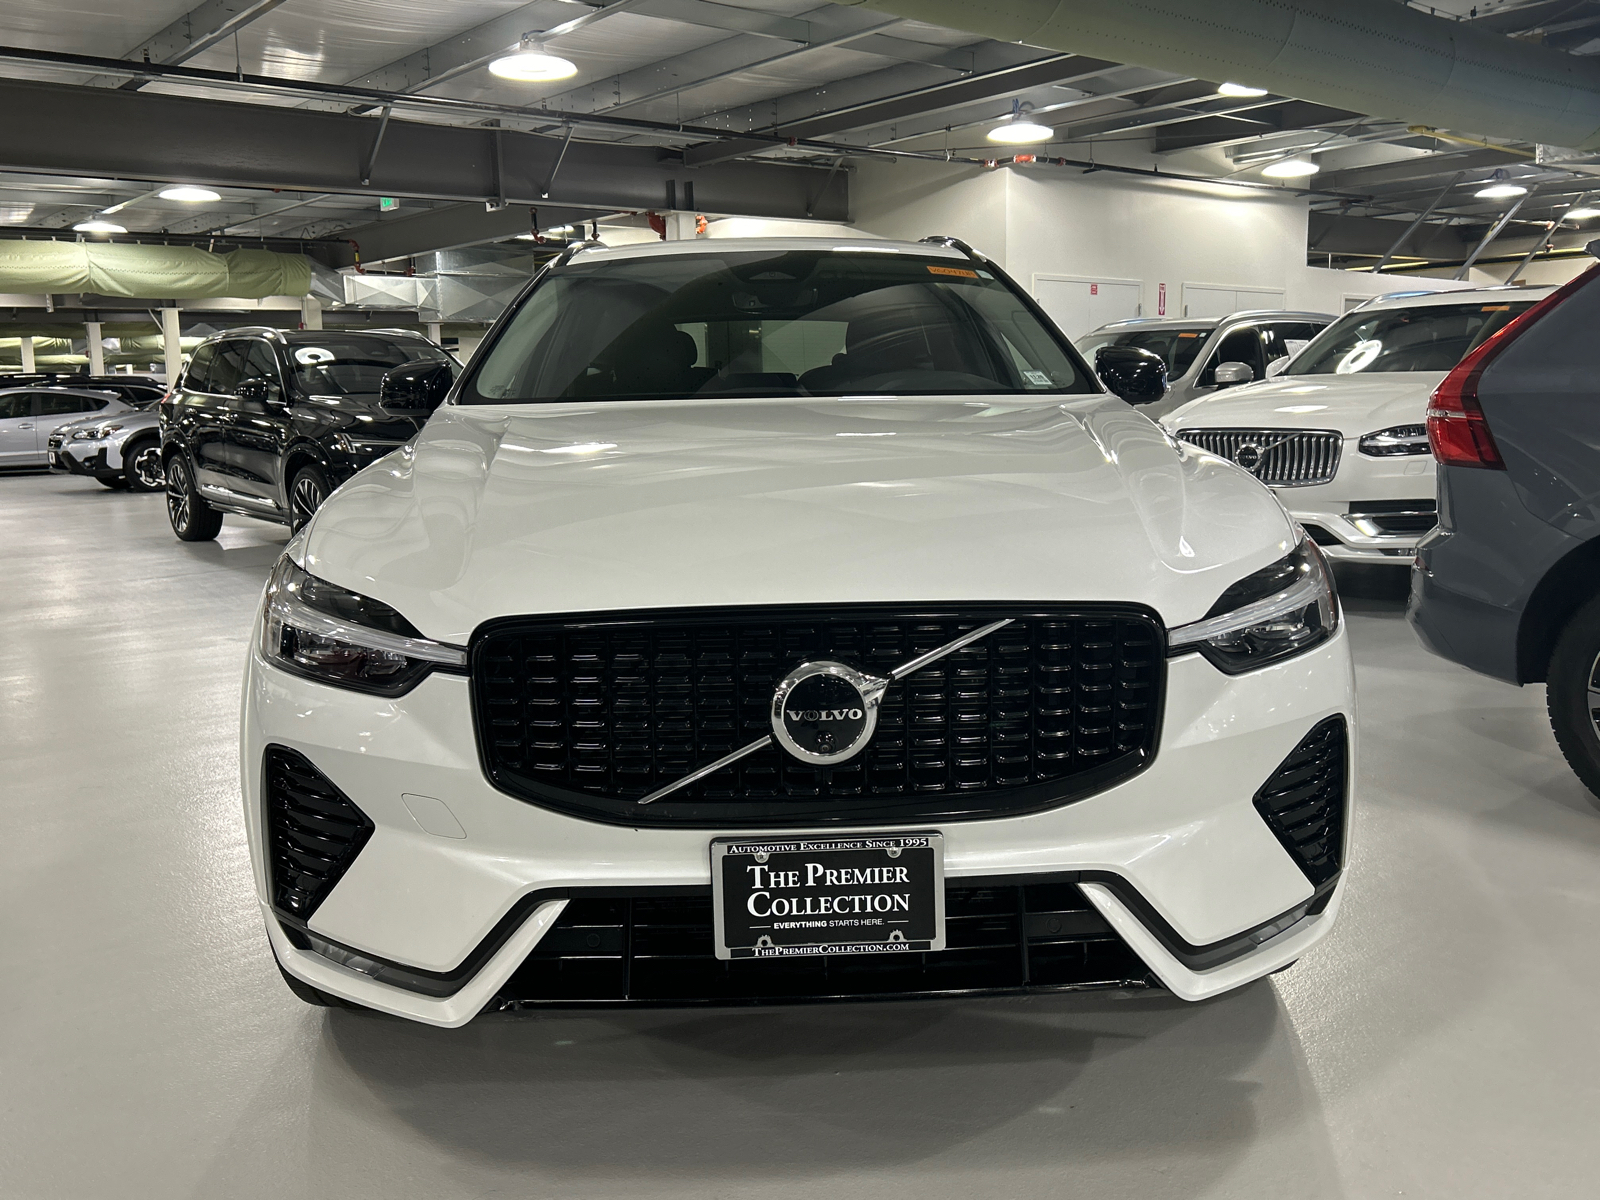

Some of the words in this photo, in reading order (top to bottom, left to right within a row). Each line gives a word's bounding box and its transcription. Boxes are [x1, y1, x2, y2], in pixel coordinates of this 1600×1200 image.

[786, 708, 863, 721] VOLVO
[729, 845, 797, 854] AUTOMOTIVE
[800, 842, 863, 851] EXCELLENCE
[865, 840, 896, 848] SINCE
[900, 838, 927, 847] 1995
[747, 865, 800, 888] THE
[804, 863, 910, 887] PREMIER
[747, 892, 910, 917] COLLECTION
[774, 920, 827, 929] EVERYTHING
[828, 919, 859, 928] STARTS
[860, 918, 885, 926] HERE.
